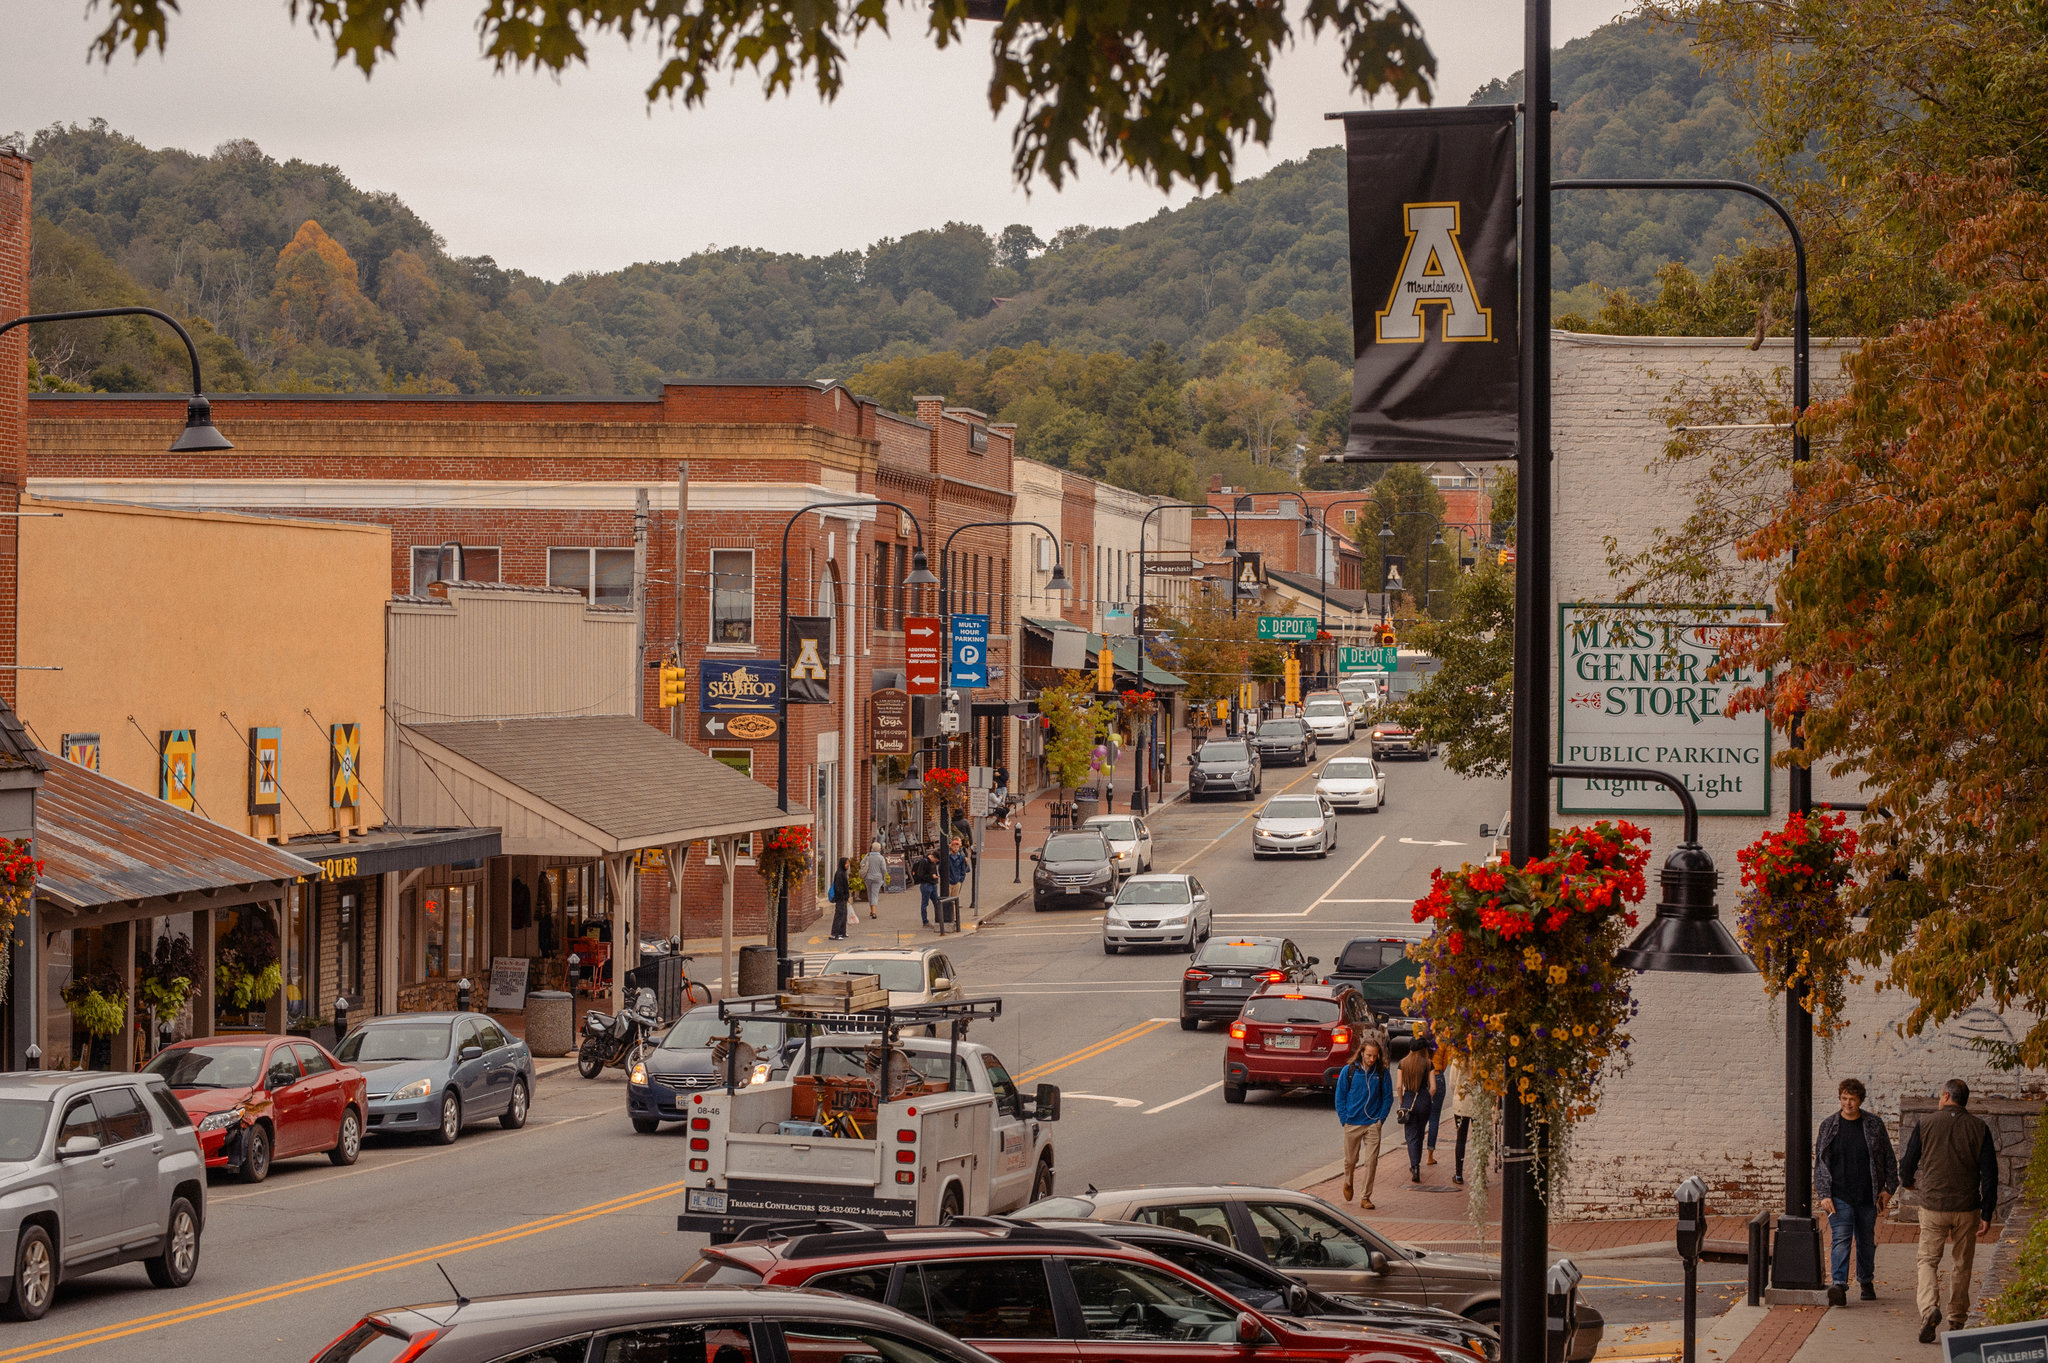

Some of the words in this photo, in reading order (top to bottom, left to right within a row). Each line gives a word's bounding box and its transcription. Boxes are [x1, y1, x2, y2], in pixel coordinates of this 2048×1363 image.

[1375, 201, 1492, 344] A
[1404, 280, 1463, 293] Mountaineers
[1240, 561, 1257, 582] A
[1387, 565, 1401, 580] A
[1260, 619, 1270, 634] S.
[1272, 619, 1304, 634] DEPOT
[1571, 620, 1678, 656] MAST
[790, 638, 827, 680] A
[964, 648, 976, 662] P
[1340, 650, 1347, 663] N
[1351, 648, 1383, 663] DEPOT
[1386, 648, 1393, 656] ST
[1385, 656, 1396, 664] 100
[708, 681, 735, 698] SKI
[1605, 687, 1723, 725] STORE
[877, 715, 903, 727] Yoga
[875, 739, 904, 750] Kindly
[1569, 746, 1650, 763] PUBLIC
[1656, 747, 1760, 764] PARKING
[1682, 773, 1743, 798] Light
[697, 1106, 720, 1115] 08-46
[818, 1204, 860, 1214] 828-432-0025
[866, 1207, 901, 1217] Morganton,
[1987, 1348, 2045, 1363] GALLERIES
